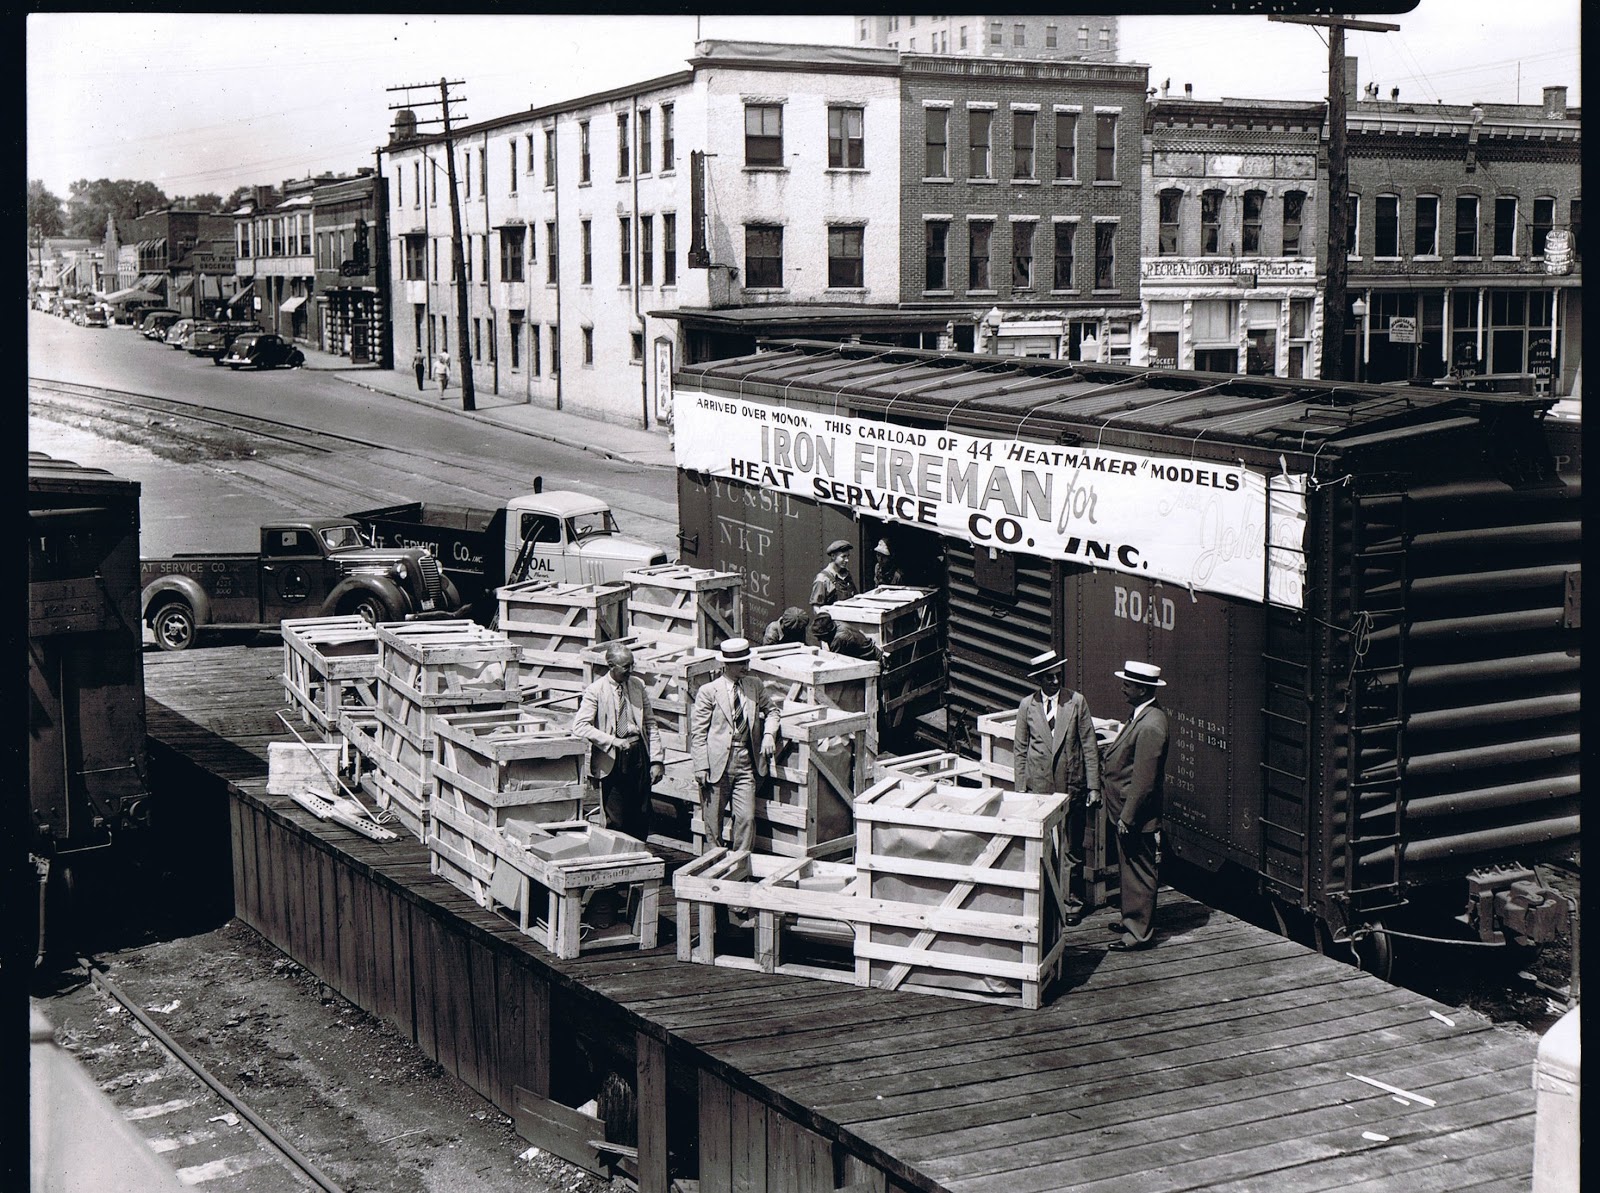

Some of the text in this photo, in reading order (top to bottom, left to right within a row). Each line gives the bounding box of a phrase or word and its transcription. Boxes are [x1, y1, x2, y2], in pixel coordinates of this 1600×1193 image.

[1532, 366, 1551, 376] LUNC
[696, 397, 738, 415] ARRIVED
[742, 406, 767, 421] OVER
[825, 420, 852, 436] THIS
[858, 426, 926, 447] CARLOAD
[938, 436, 958, 451] OF
[966, 440, 993, 461] 44
[1150, 463, 1240, 491] MODELS
[761, 425, 1098, 535] IRON FIREMAN for
[731, 458, 1149, 570] HEAT SERVICE CO. INC.
[160, 562, 204, 573] SERVICE
[521, 557, 555, 572] OAL
[1114, 586, 1176, 631] ROAD
